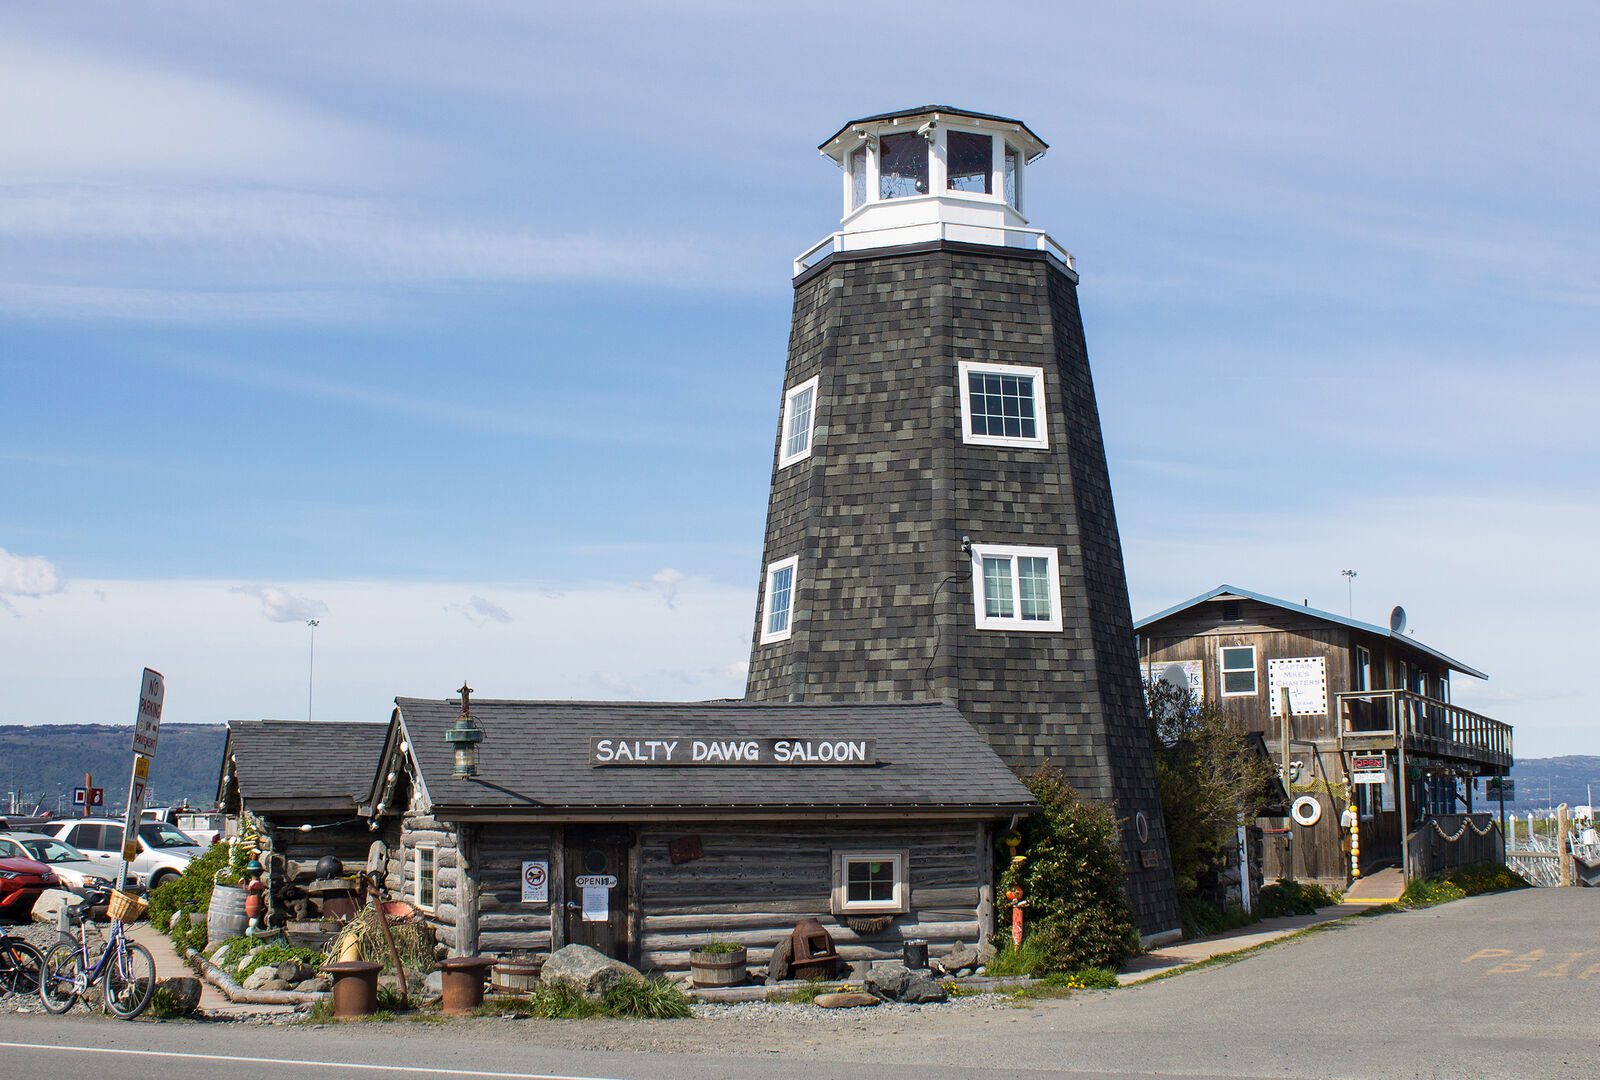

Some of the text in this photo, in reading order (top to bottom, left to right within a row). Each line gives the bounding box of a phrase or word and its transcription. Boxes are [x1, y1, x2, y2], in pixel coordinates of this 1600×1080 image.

[1278, 663, 1313, 671] CAPTAIN
[148, 678, 159, 697] NO
[1275, 679, 1321, 688] CHARTERS
[141, 698, 161, 719] PARKING
[596, 740, 866, 761] SALTY DAWG SALOON
[1354, 759, 1383, 767] OPEN
[577, 877, 601, 885] OPEN
